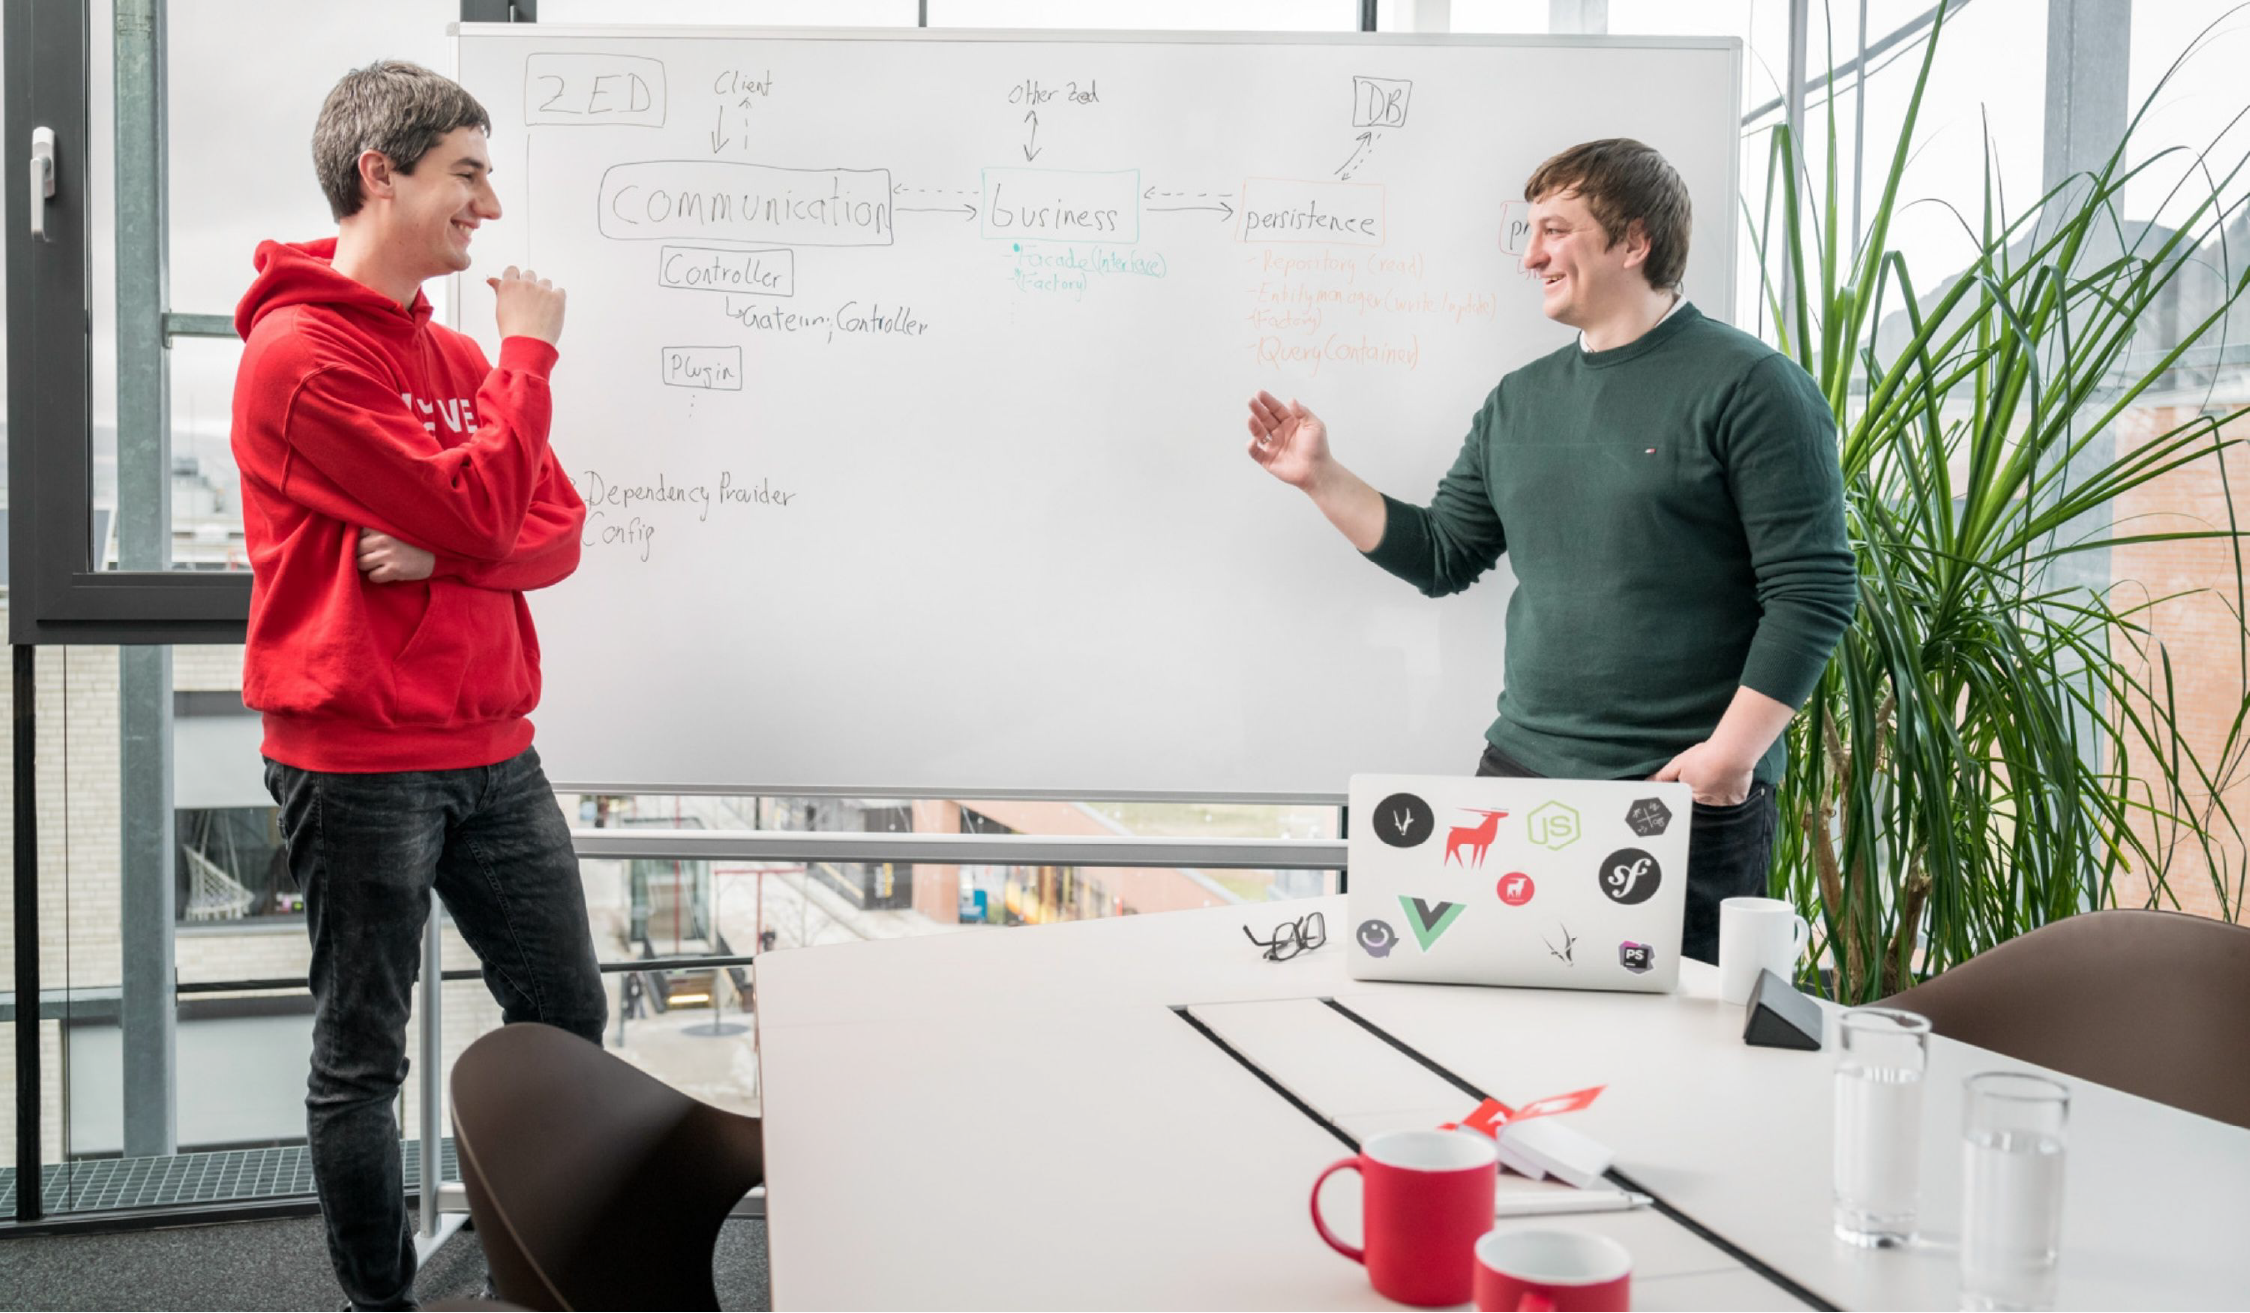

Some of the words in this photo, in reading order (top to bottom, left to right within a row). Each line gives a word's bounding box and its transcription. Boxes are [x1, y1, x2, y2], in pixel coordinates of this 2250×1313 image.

[714, 69, 774, 97] Client
[1360, 80, 1402, 126] DB
[991, 182, 1118, 232] business
[1244, 199, 1376, 243] persistence
[664, 253, 783, 289] Controller
[584, 471, 710, 522] Dependency
[582, 511, 655, 563] Config
[1625, 949, 1645, 960] PS
